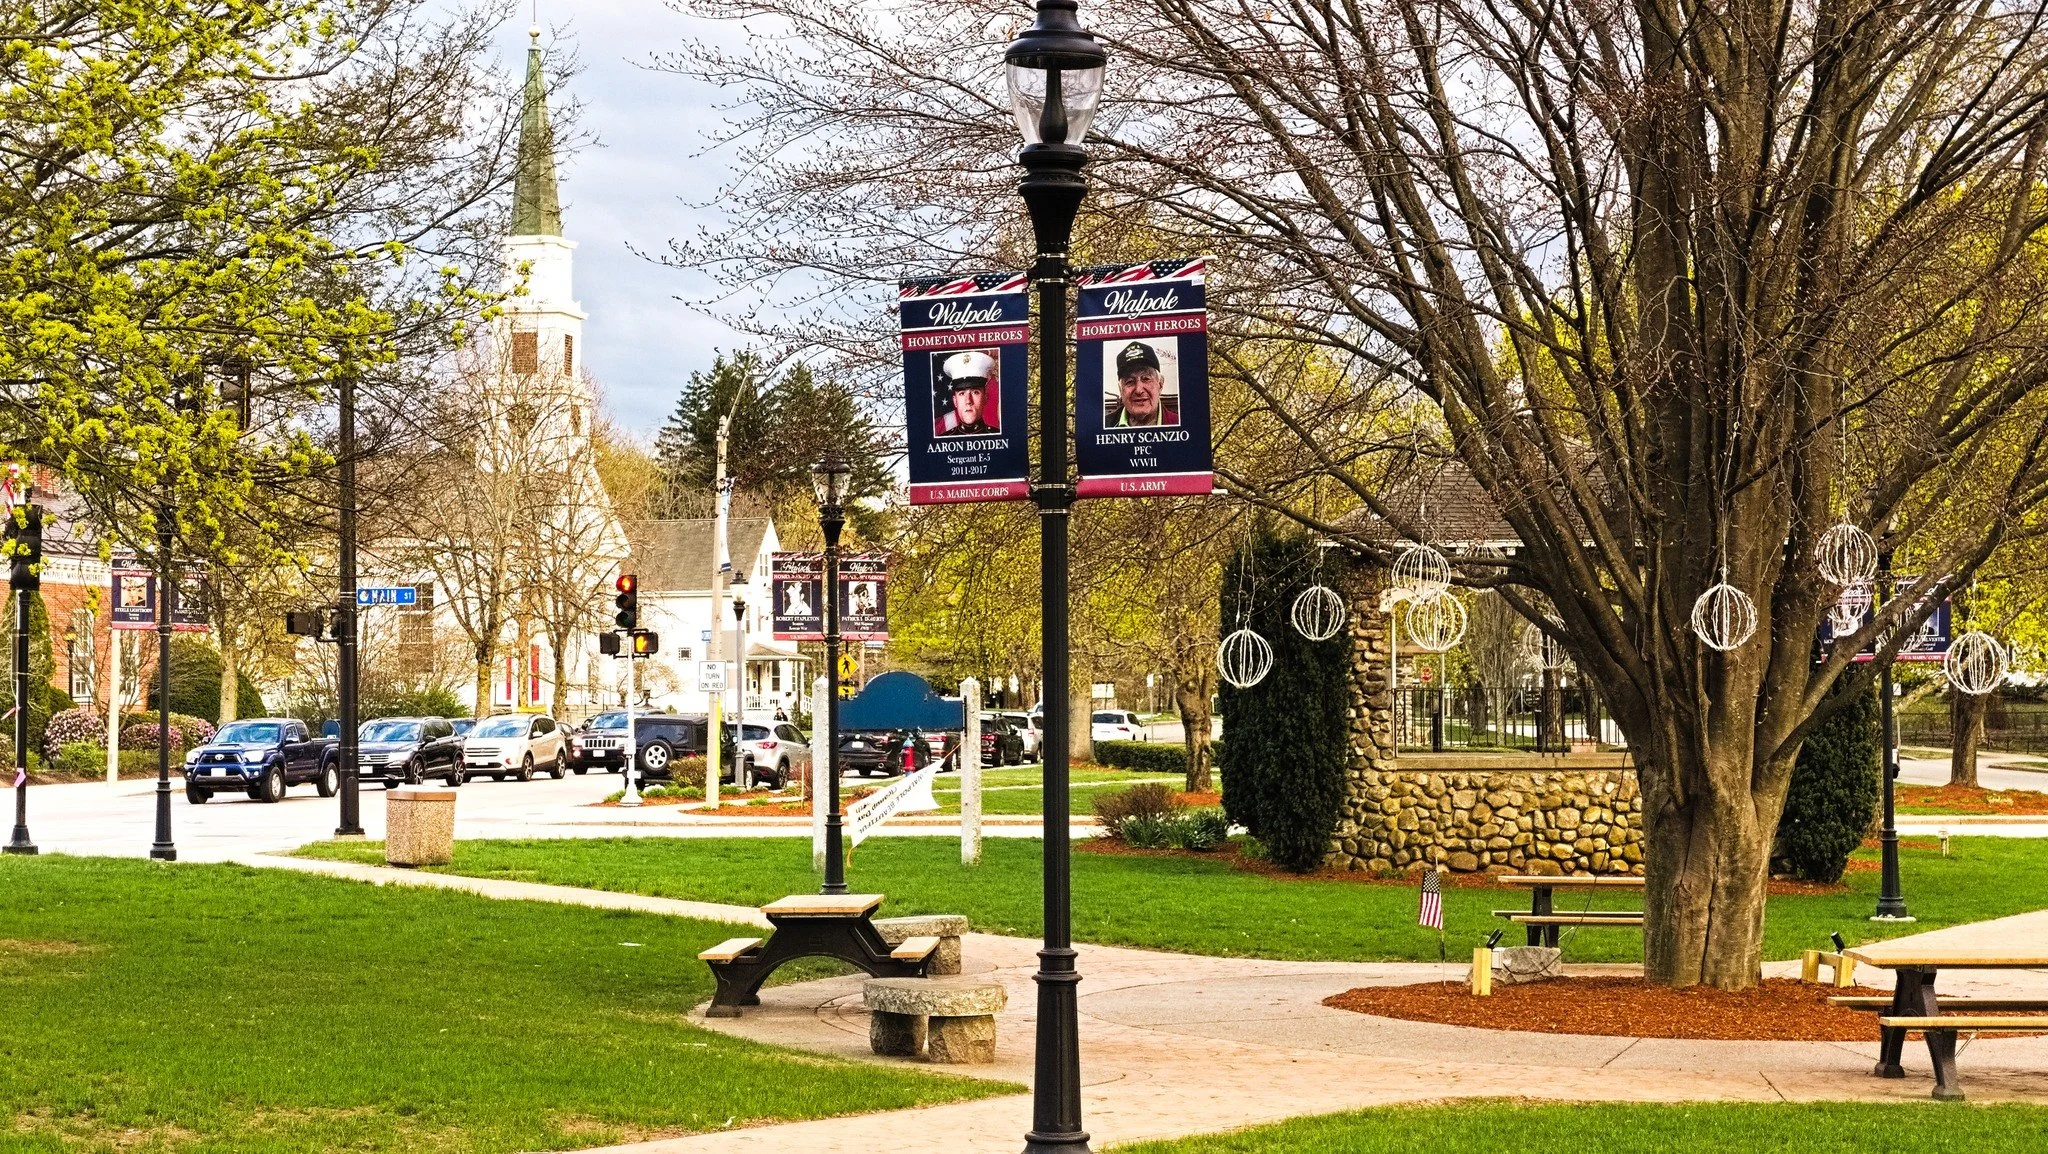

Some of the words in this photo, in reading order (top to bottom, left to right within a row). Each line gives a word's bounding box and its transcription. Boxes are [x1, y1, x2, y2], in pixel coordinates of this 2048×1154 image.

[1104, 288, 1178, 319] Walpole
[929, 300, 1002, 330] Walpole
[1082, 323, 1151, 337] HOMETOWN
[1154, 319, 1201, 333] HEROES
[908, 335, 976, 348] HOMETOWN
[978, 331, 1023, 344] HEROES
[1095, 433, 1135, 445] HENRY
[1138, 431, 1189, 443] SCANZIO
[927, 441, 964, 453] AARON
[966, 438, 1009, 451] BOYDEN
[1134, 445, 1152, 455] PFC
[947, 454, 976, 464] Sergeant
[978, 453, 991, 463] E-5
[1129, 457, 1157, 467] WWII
[951, 465, 988, 476] 2011-2017
[1120, 482, 1137, 492] U.S.
[1138, 481, 1167, 492] ARMY
[929, 489, 945, 500] U.S.
[946, 488, 979, 499] MARINE
[979, 487, 1009, 498] CORPS
[372, 589, 396, 602] MAIN
[404, 592, 412, 600] ST
[856, 811, 871, 823] Day
[859, 801, 896, 834] BEAUTIFUL
